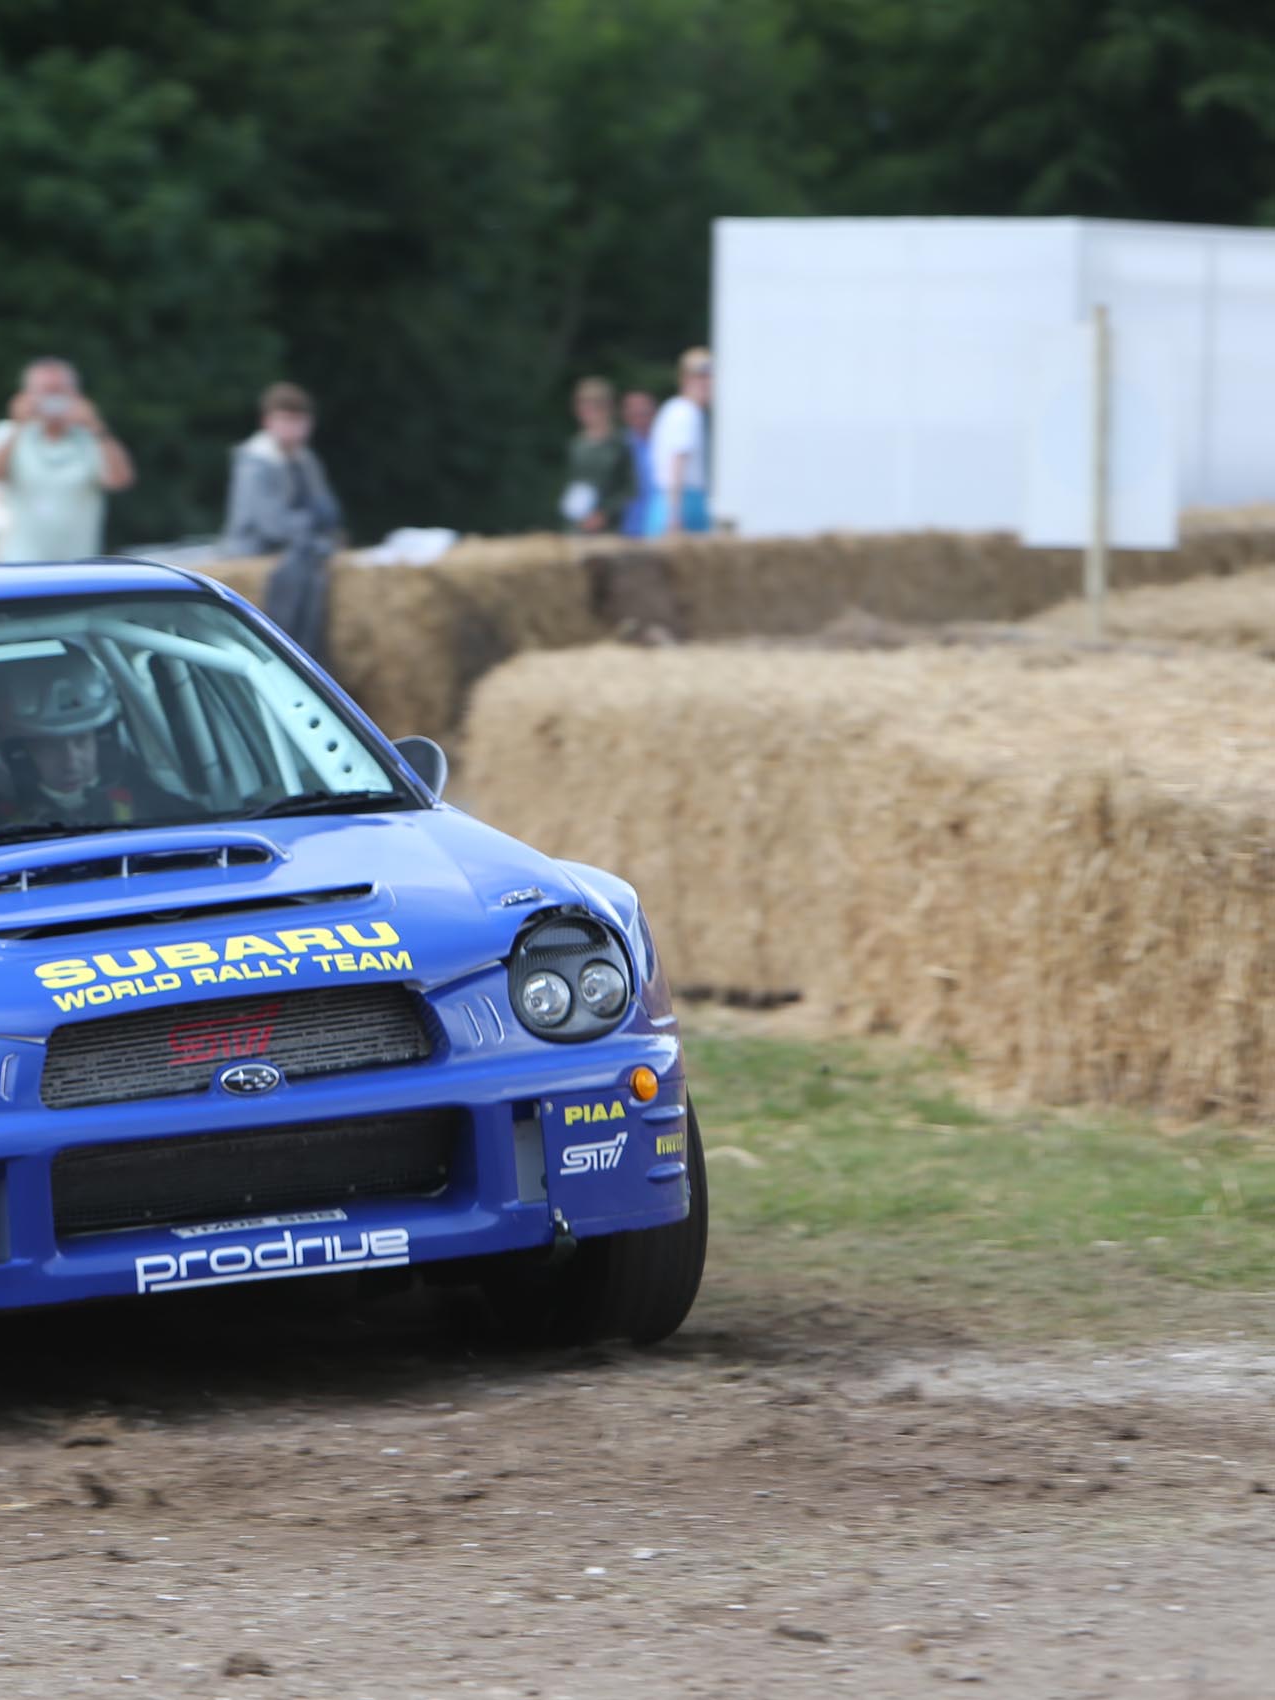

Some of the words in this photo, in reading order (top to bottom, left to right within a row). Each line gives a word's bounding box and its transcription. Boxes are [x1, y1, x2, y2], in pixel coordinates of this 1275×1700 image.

[34, 921, 401, 989] SUBARU
[52, 973, 182, 1012] WORLD
[191, 958, 302, 986] RALLY
[317, 950, 414, 973] TEAM
[564, 1100, 626, 1126] PIAA
[135, 1228, 409, 1294] prodrive
